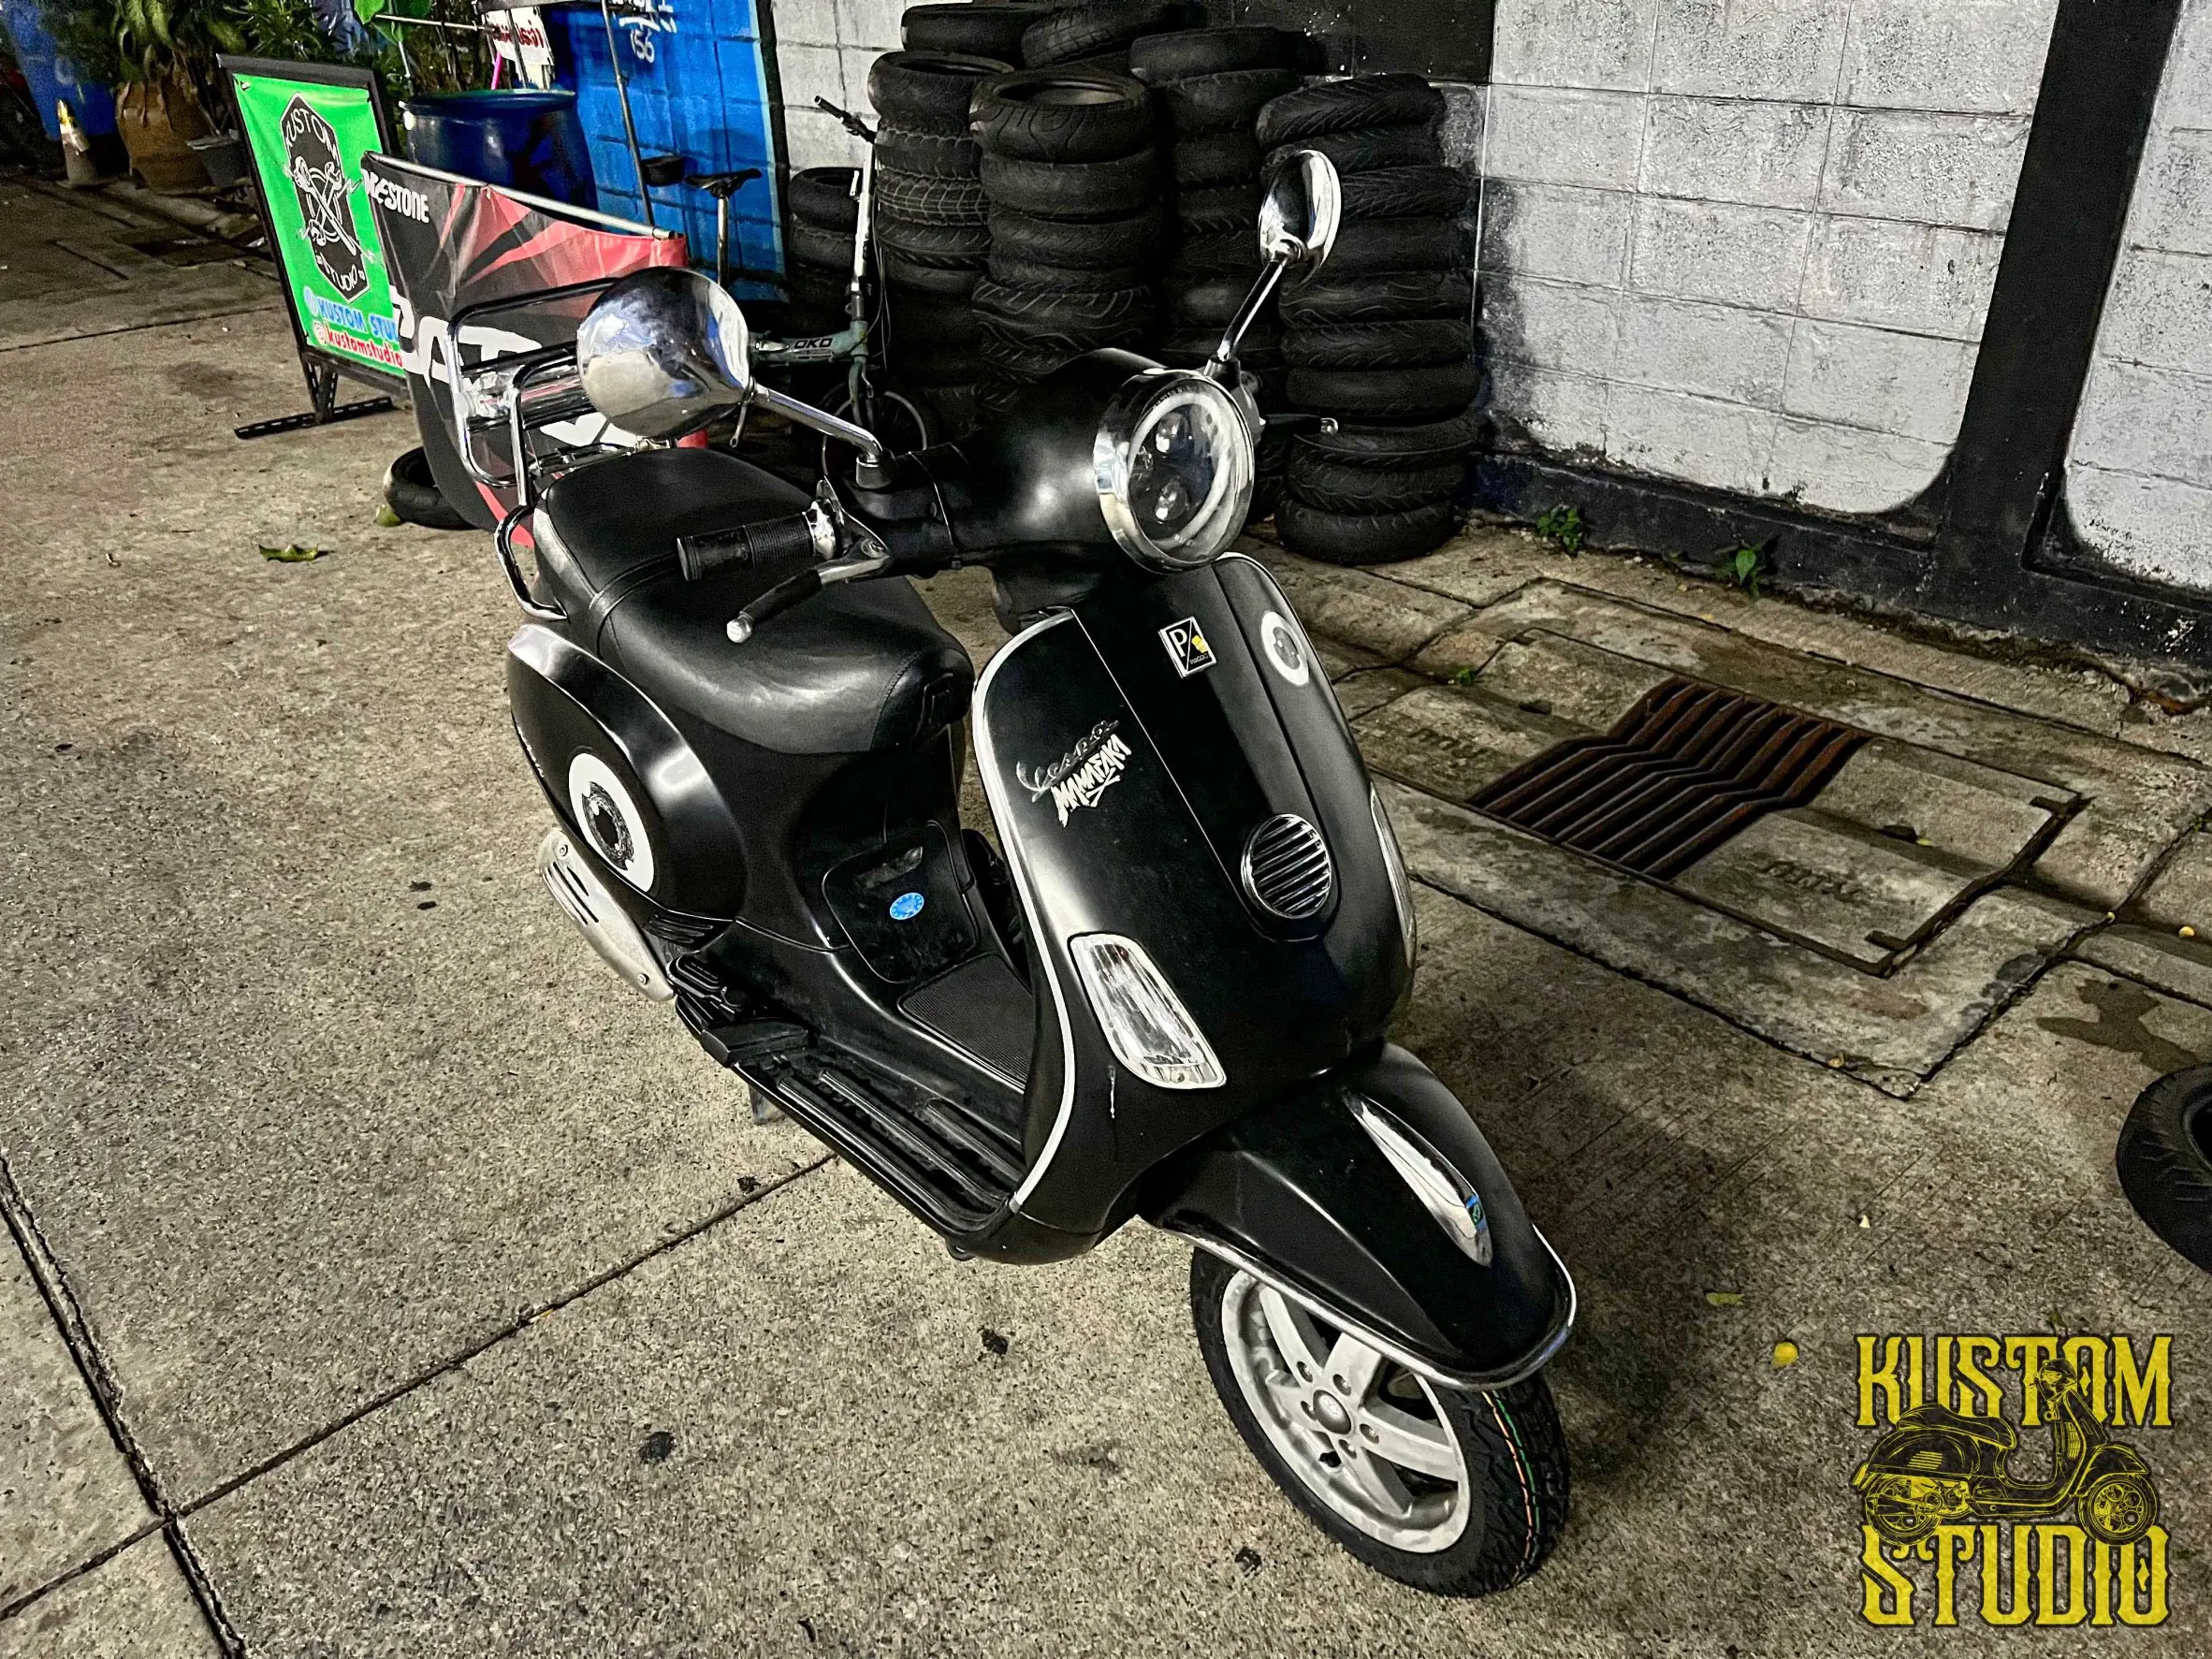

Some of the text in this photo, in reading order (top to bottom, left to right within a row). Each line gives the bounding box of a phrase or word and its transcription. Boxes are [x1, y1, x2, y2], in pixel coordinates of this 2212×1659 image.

[284, 108, 341, 167] KUSTOM
[319, 252, 358, 291] STUDIO
[316, 296, 368, 334] KUSTOM
[793, 338, 833, 349] OKO
[1169, 628, 1188, 658] P
